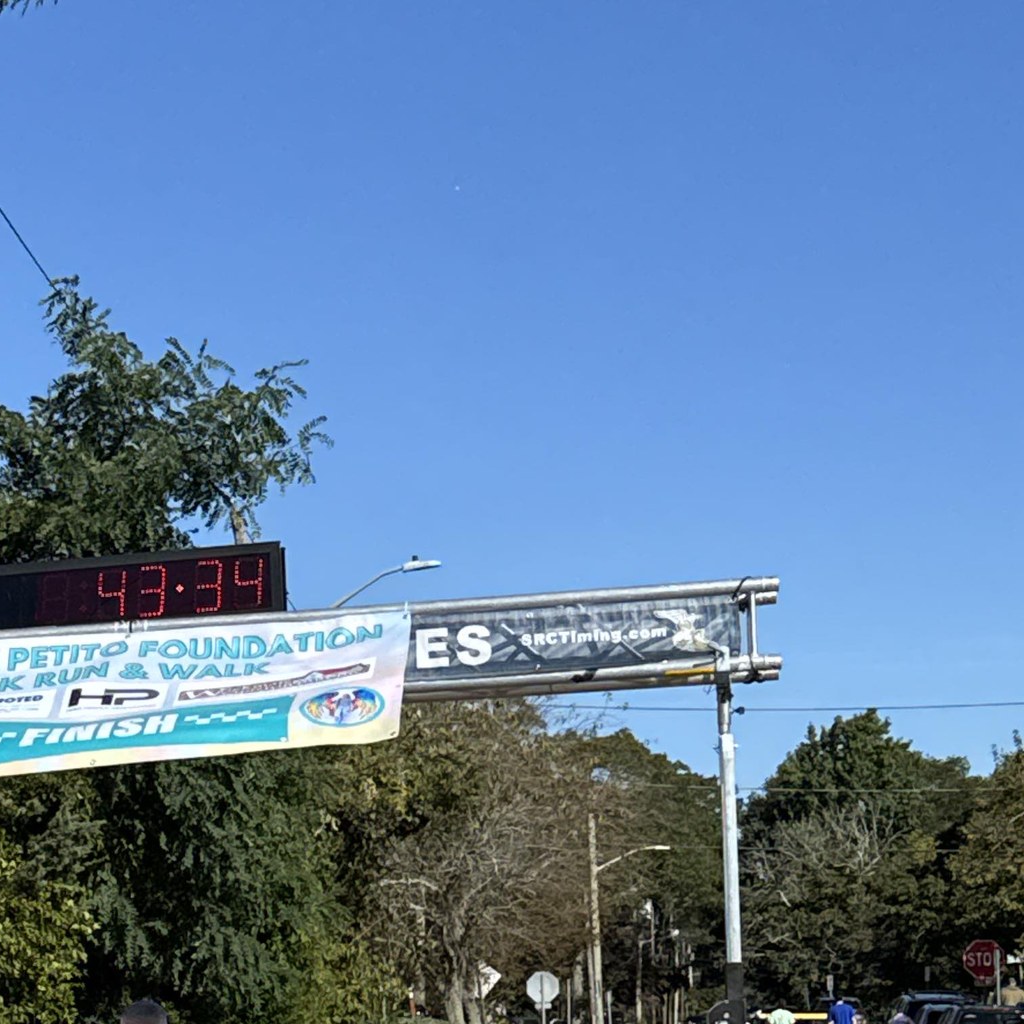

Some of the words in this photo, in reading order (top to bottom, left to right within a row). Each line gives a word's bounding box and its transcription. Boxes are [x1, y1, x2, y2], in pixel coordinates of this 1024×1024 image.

[7, 640, 130, 672] PETITO
[138, 624, 383, 660] FOUNDATION
[521, 627, 667, 647] SRCTiming.com
[34, 661, 110, 689] RUN
[119, 662, 149, 680] &
[158, 661, 271, 680] WALK
[68, 688, 160, 707] HP
[19, 713, 179, 747] FINISH
[967, 952, 996, 967] STO
